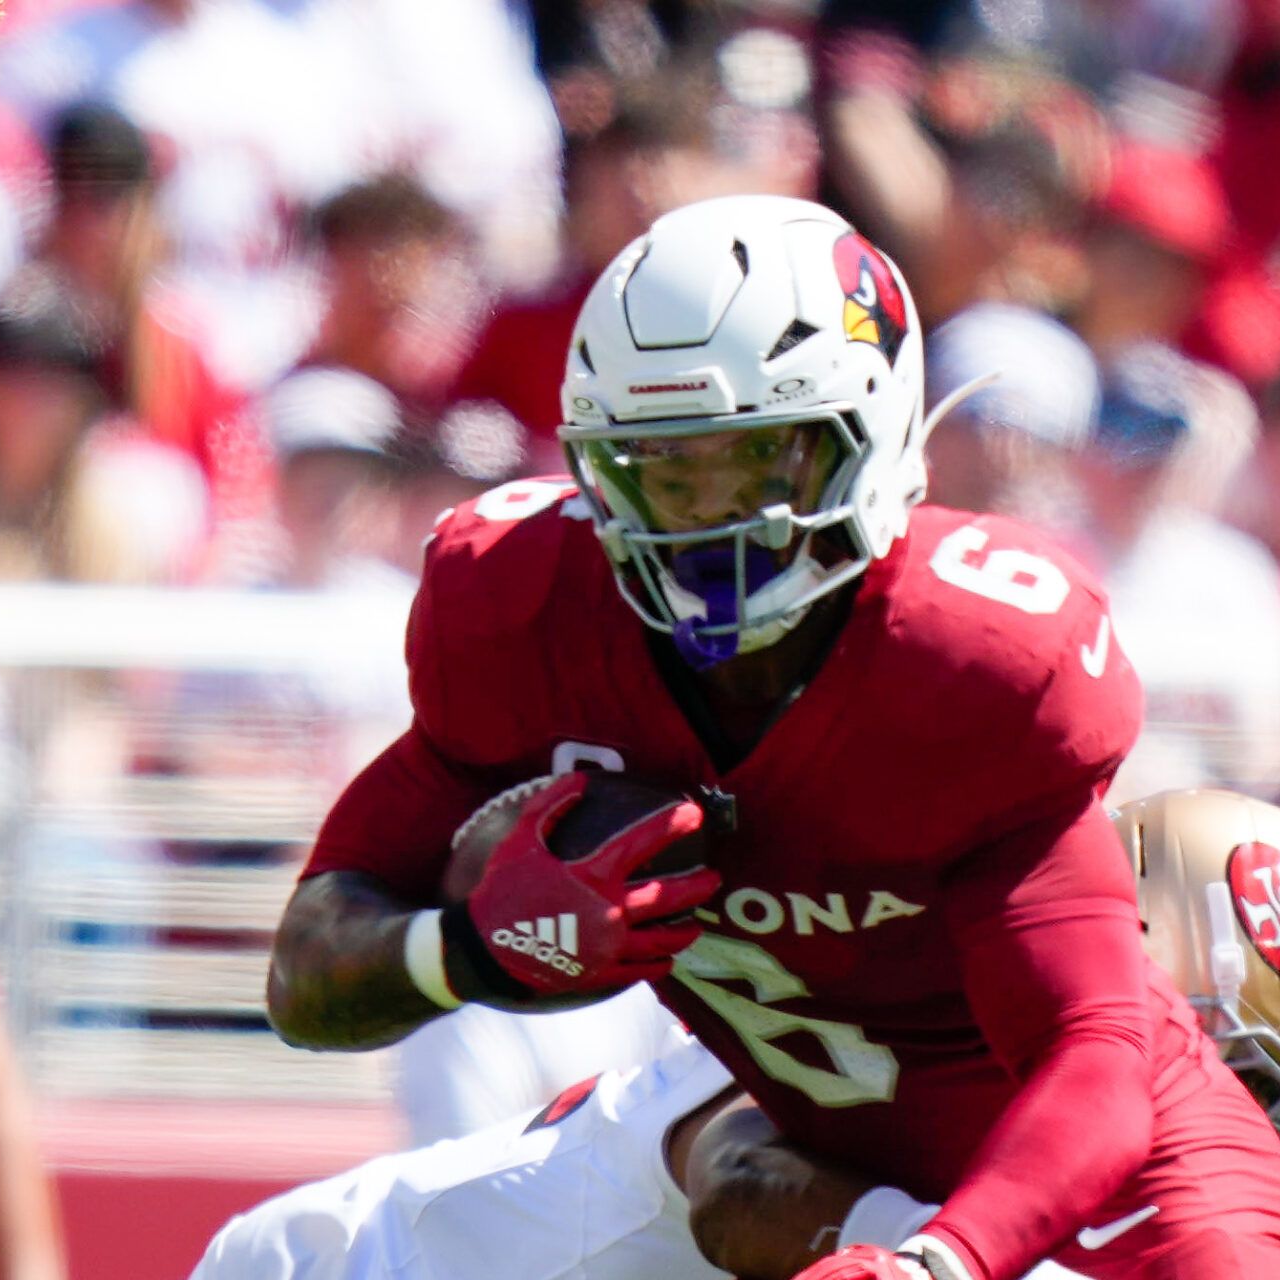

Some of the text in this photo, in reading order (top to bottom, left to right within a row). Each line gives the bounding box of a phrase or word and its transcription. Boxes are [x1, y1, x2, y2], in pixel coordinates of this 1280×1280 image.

[928, 525, 1070, 614] 6
[694, 887, 926, 935] ONA
[491, 928, 584, 977] adidas
[671, 931, 900, 1108] 6
